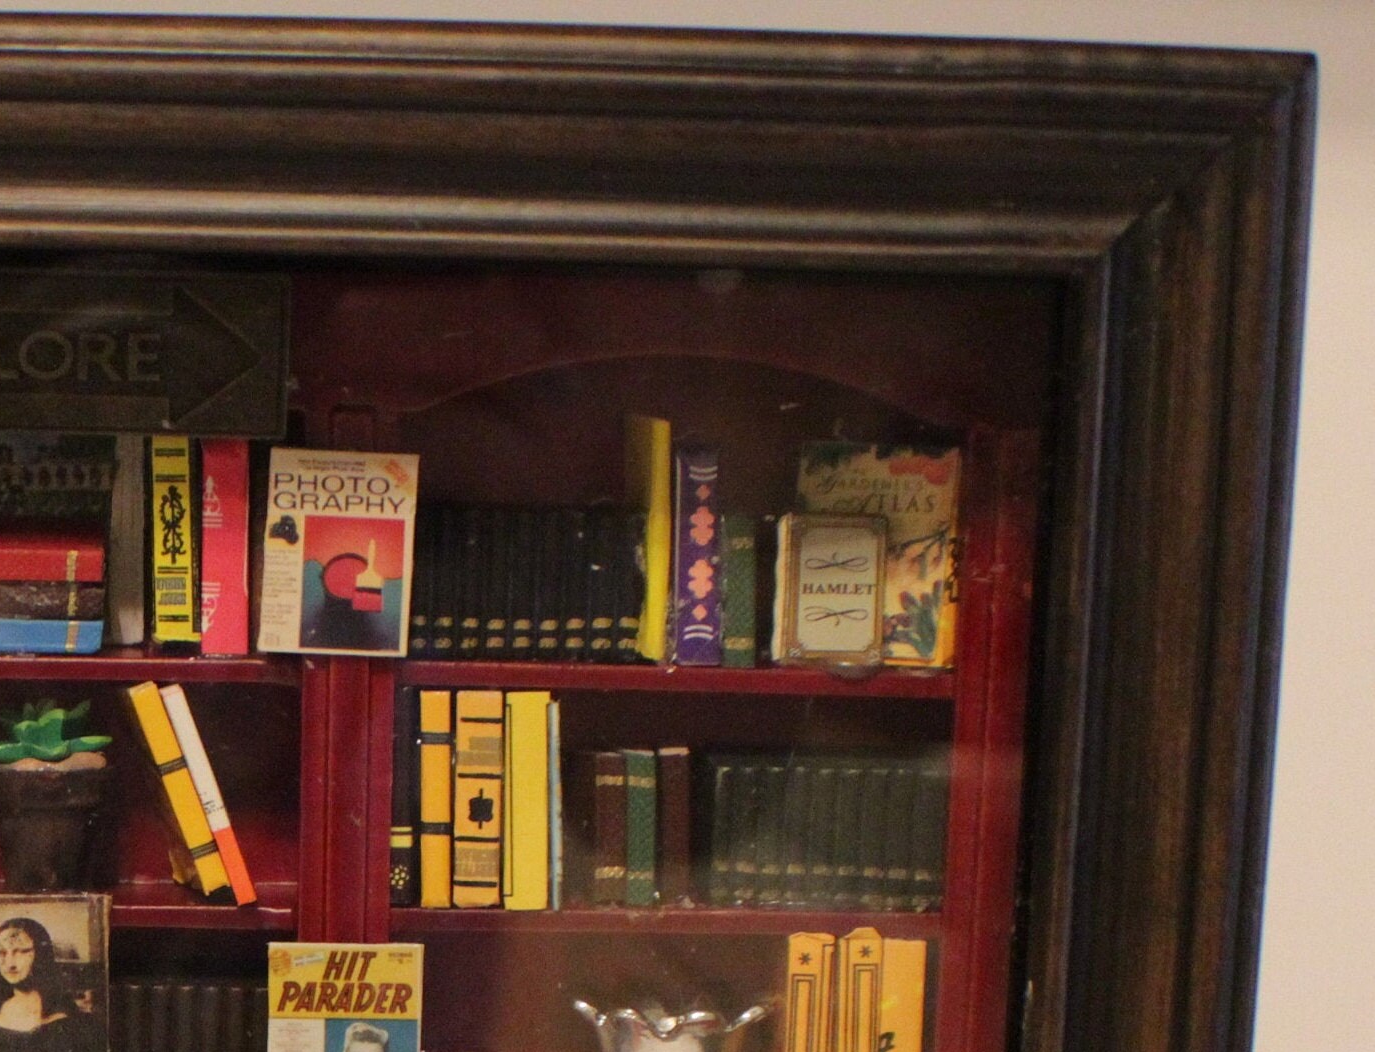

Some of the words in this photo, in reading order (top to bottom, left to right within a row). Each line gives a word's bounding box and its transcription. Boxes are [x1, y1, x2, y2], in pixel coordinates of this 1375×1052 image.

[274, 472, 391, 495] PHOTO
[273, 491, 406, 514] GRAPHY
[801, 581, 877, 596] HAMLET
[322, 950, 378, 982] HIT
[277, 981, 413, 1014] PARADER
